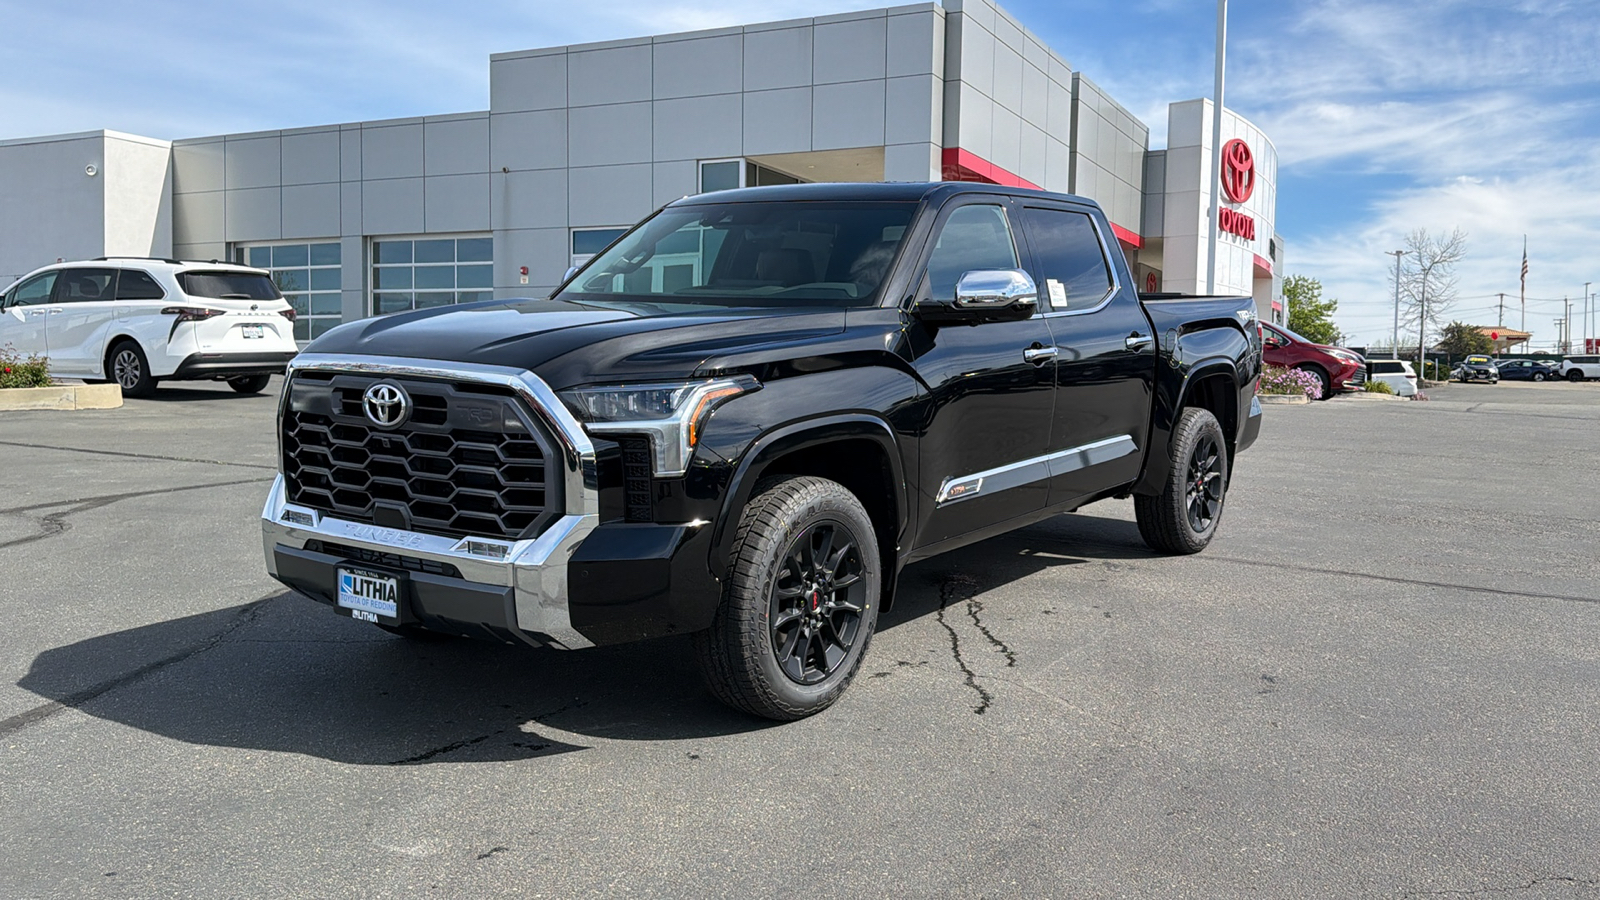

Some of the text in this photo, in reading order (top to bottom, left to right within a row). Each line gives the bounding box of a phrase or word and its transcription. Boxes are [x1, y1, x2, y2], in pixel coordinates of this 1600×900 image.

[1218, 206, 1255, 241] OYOTA
[456, 405, 493, 421] TRD
[353, 577, 396, 603] LITHIA
[340, 594, 360, 604] TOYOTA
[361, 598, 370, 606] OF
[358, 610, 378, 623] LITHIA
